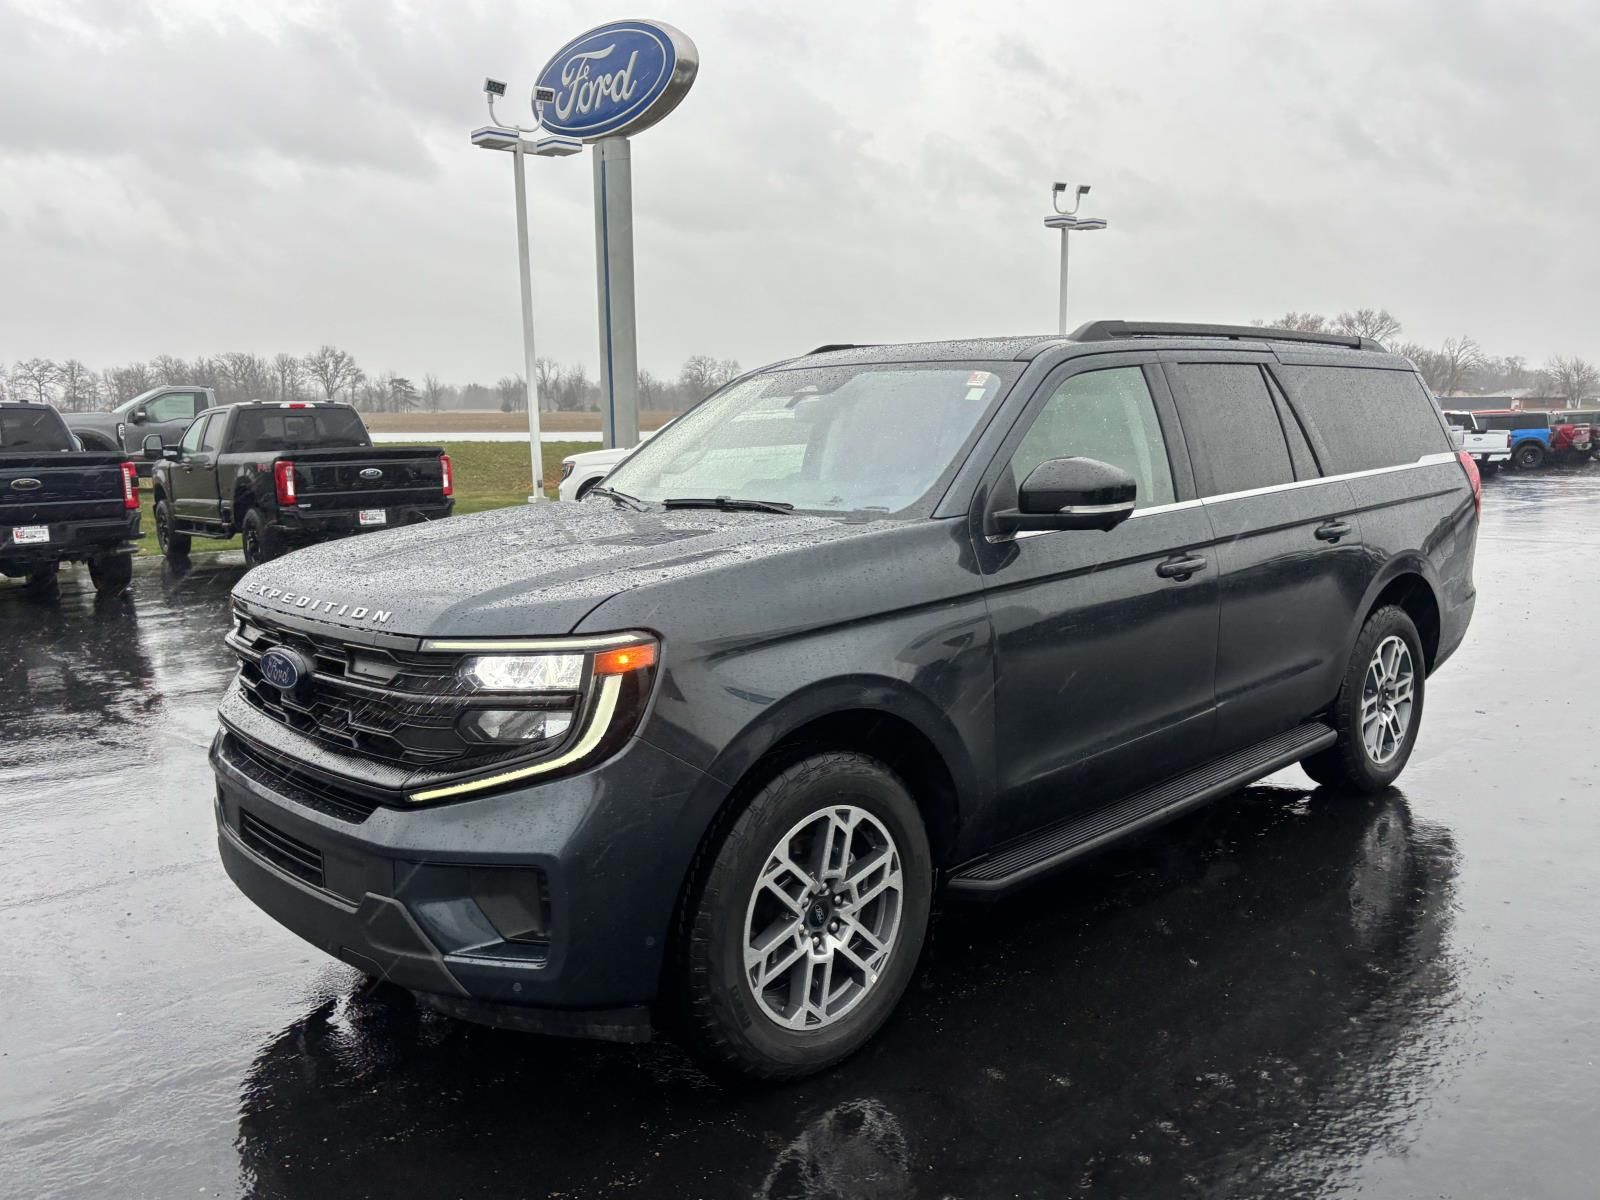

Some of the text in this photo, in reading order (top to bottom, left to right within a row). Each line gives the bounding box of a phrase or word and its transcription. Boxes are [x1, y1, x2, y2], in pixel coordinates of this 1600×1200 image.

[556, 43, 639, 120] Ford
[247, 582, 392, 624] EXPEDITION
[266, 655, 289, 684] Ford
